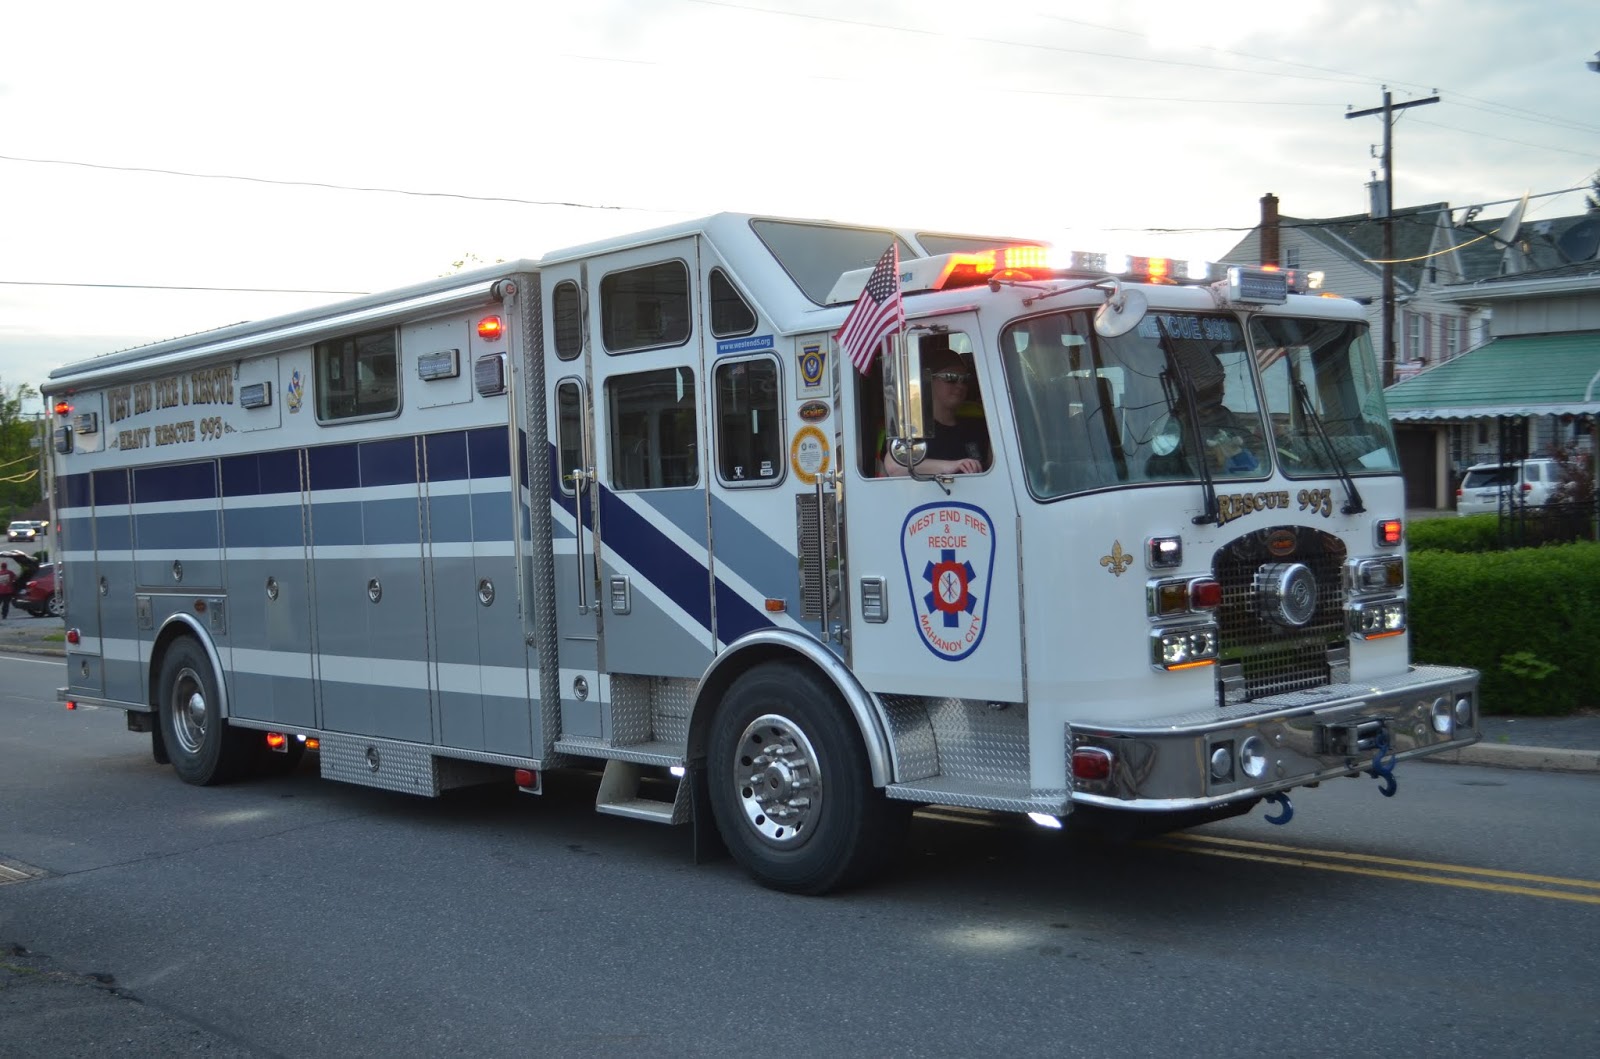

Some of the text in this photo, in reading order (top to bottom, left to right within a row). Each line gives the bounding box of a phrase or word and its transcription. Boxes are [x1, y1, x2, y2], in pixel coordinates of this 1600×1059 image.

[1202, 317, 1231, 341] 993
[134, 382, 152, 415] END
[155, 377, 179, 410] FIRE
[191, 367, 234, 405] RESCUE
[119, 416, 223, 451] HEAVY RESCUE 993
[909, 510, 987, 537] WEST END FIRE
[1216, 491, 1289, 528] RESCUE
[928, 536, 967, 548] RESCUE
[944, 524, 950, 534] &
[920, 614, 981, 652] MAHANOY CITY
